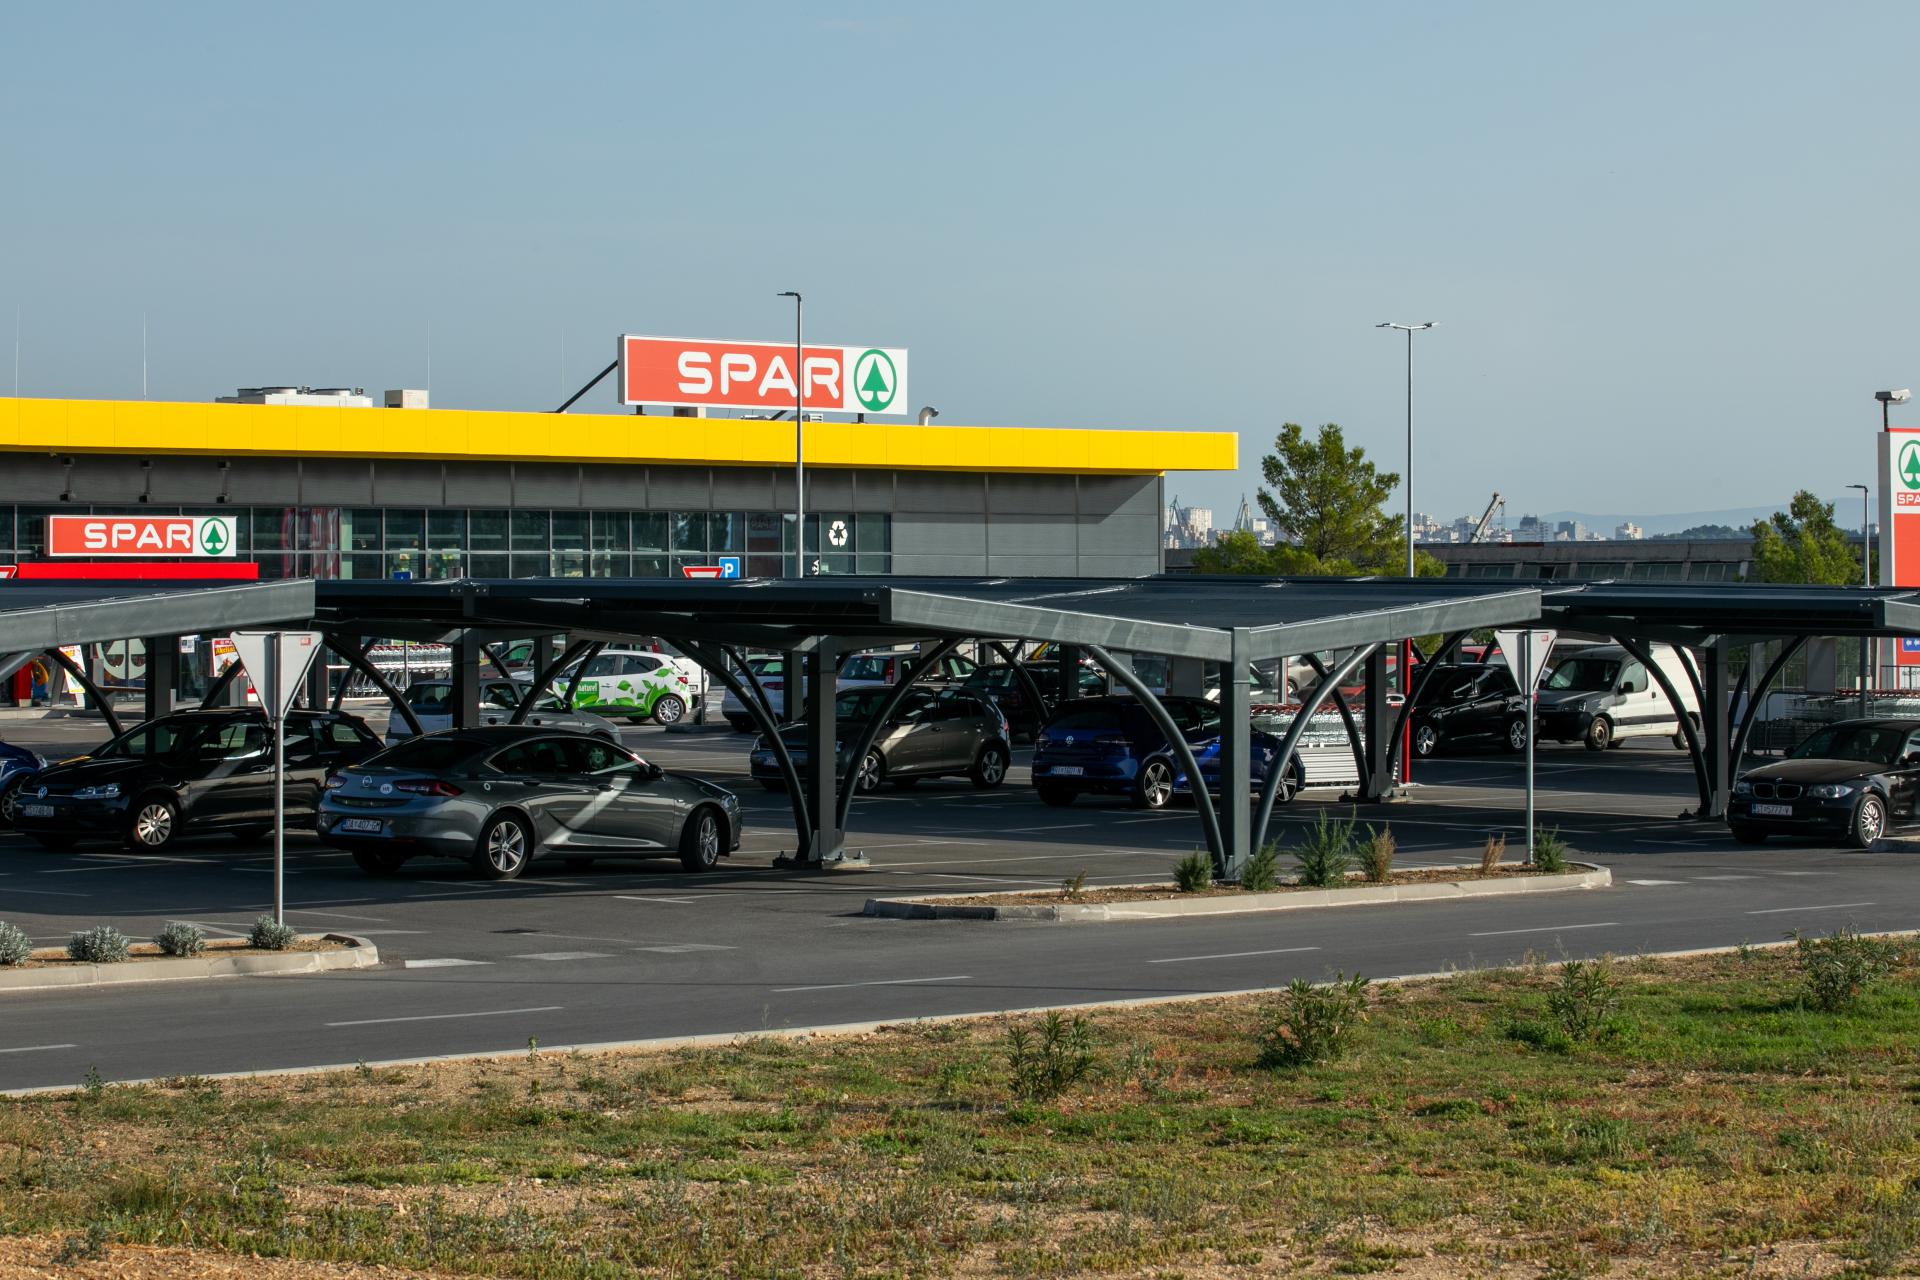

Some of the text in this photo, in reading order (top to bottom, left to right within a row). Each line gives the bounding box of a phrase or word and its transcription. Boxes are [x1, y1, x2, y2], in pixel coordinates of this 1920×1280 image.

[678, 351, 840, 400] SPAR
[84, 522, 192, 549] SPAR
[724, 563, 733, 578] P
